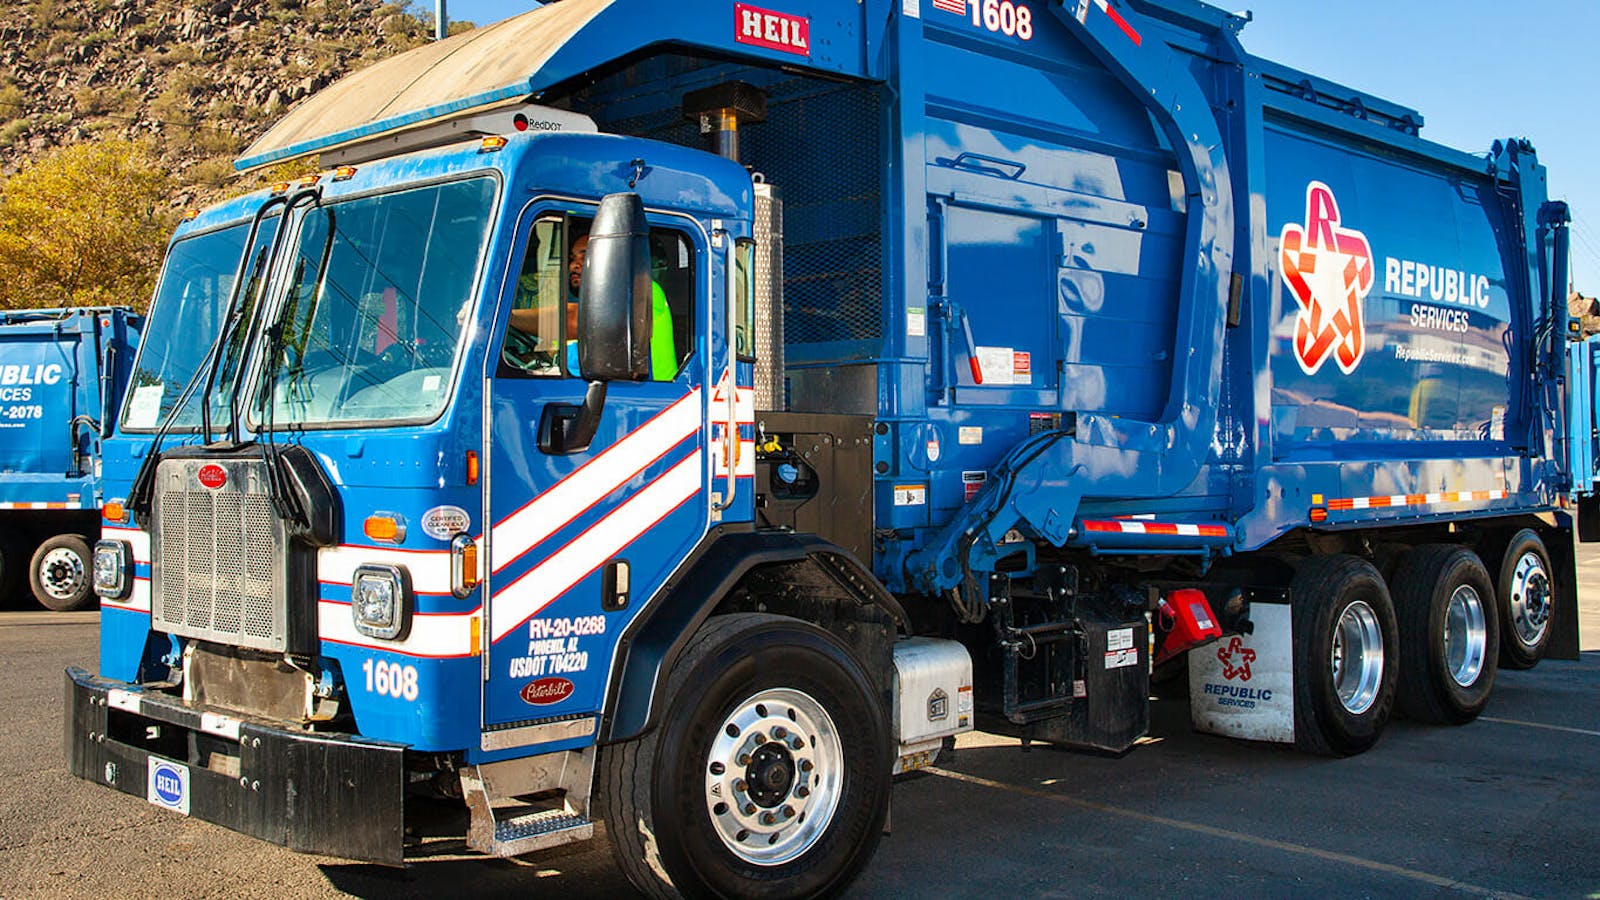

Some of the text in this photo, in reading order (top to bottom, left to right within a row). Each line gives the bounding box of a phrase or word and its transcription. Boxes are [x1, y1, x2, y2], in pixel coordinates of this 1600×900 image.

[742, 9, 807, 48] HEIL
[967, 0, 1033, 40] 1608
[1385, 256, 1490, 309] REPUBLIC
[1410, 303, 1469, 333] SERVICES
[0, 364, 62, 385] BLIC
[529, 615, 606, 639] RV-20-0268
[509, 651, 588, 679] USDOT 704220
[362, 658, 419, 702] 1608
[526, 682, 570, 701] Peterbilt
[1204, 683, 1272, 701] REPUBLIC
[1218, 698, 1256, 709] SERVICES
[156, 773, 181, 796] HEIL
